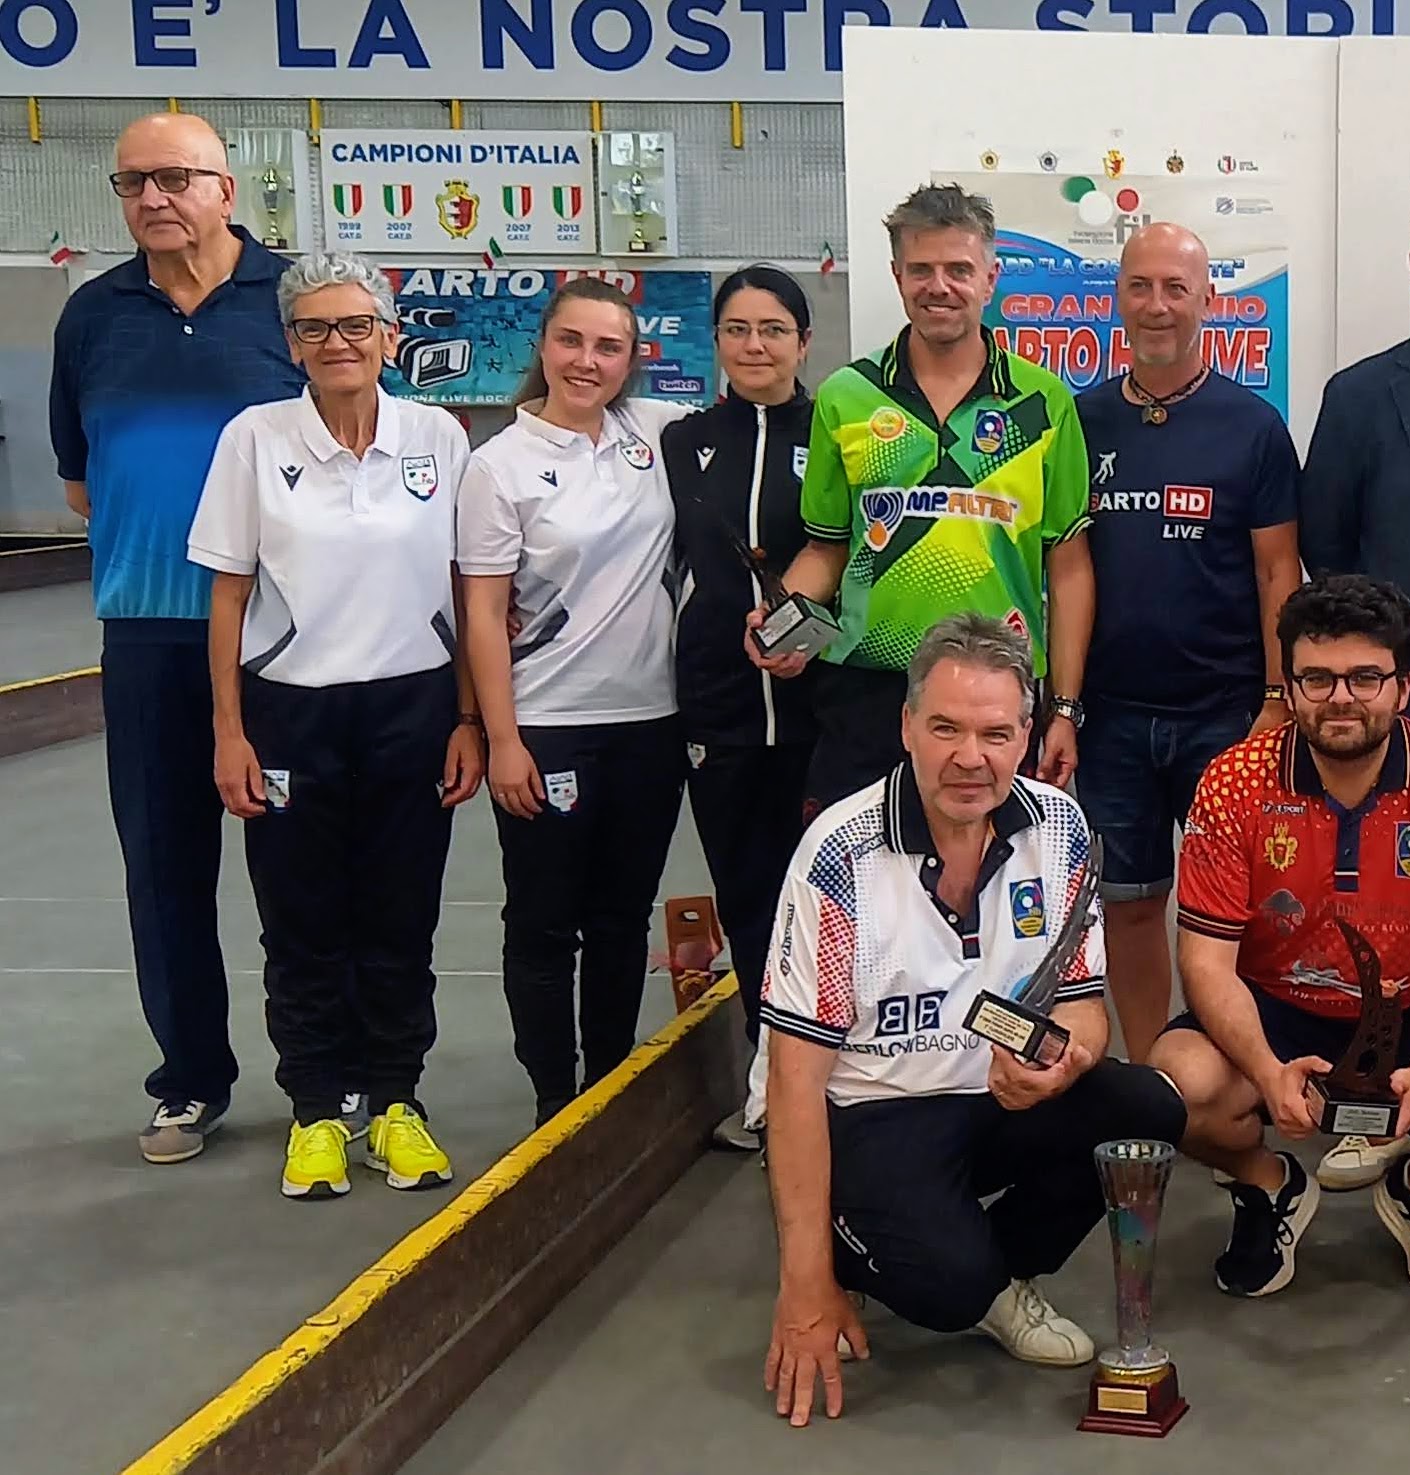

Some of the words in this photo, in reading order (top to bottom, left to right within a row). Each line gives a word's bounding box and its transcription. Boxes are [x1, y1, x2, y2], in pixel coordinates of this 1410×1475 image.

[275, 0, 431, 68] LA
[332, 143, 461, 164] CAMPIONI
[471, 144, 581, 164] D'ITALIA
[401, 268, 545, 297] ARTO
[1001, 294, 1112, 323] GRAN
[636, 315, 681, 335] VE
[1169, 492, 1206, 512] HD
[1163, 524, 1205, 540] LIVE
[915, 1033, 981, 1053] BAGNO
